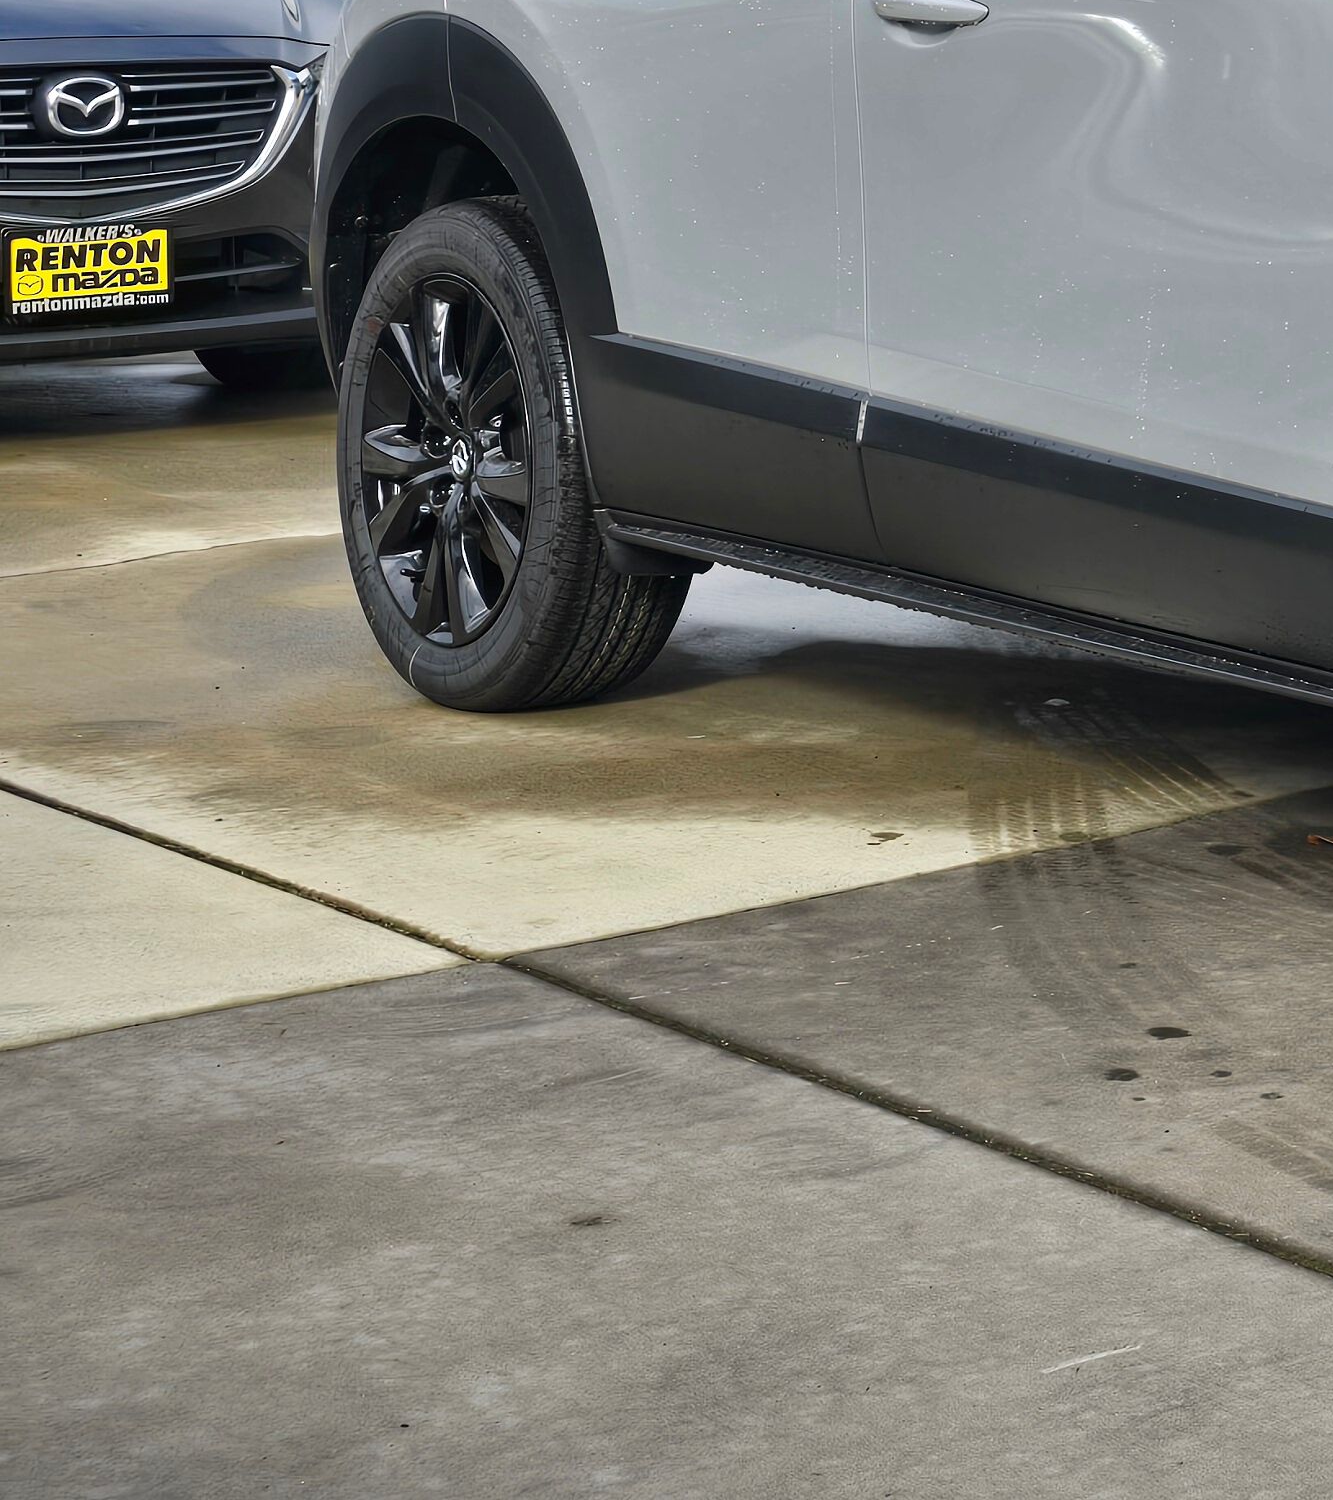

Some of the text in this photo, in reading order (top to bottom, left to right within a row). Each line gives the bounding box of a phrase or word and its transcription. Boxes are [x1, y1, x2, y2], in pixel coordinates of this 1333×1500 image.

[45, 224, 135, 244] WALKER'S
[16, 239, 161, 272] RENTON
[52, 267, 158, 292] mazda
[12, 291, 169, 315] rentonmazda.com
